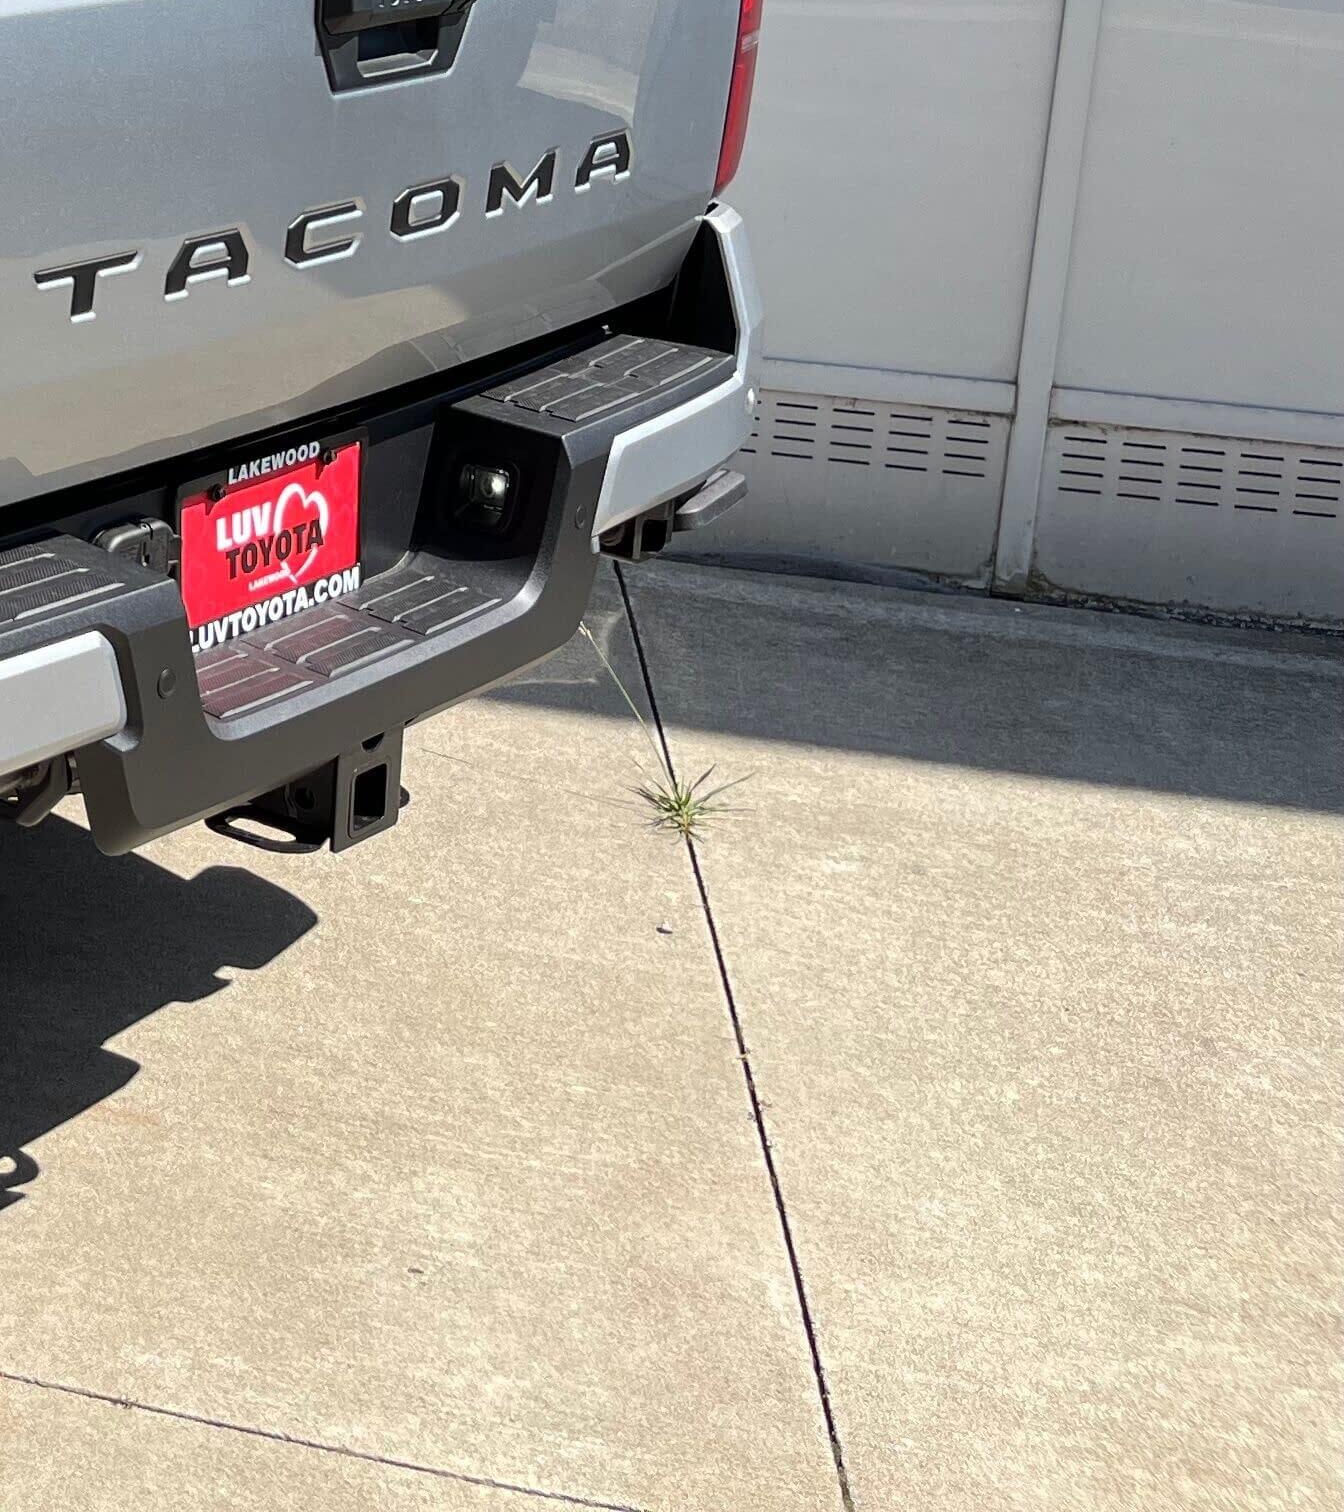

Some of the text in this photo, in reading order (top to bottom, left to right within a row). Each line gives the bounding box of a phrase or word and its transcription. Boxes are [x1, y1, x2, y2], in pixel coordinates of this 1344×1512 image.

[33, 128, 632, 323] TACOMA
[228, 441, 321, 485] LAKEWOOD
[216, 501, 272, 551] LUV
[225, 518, 324, 580] TOYOTA
[189, 565, 361, 653] LUVTOYOTA.COM
